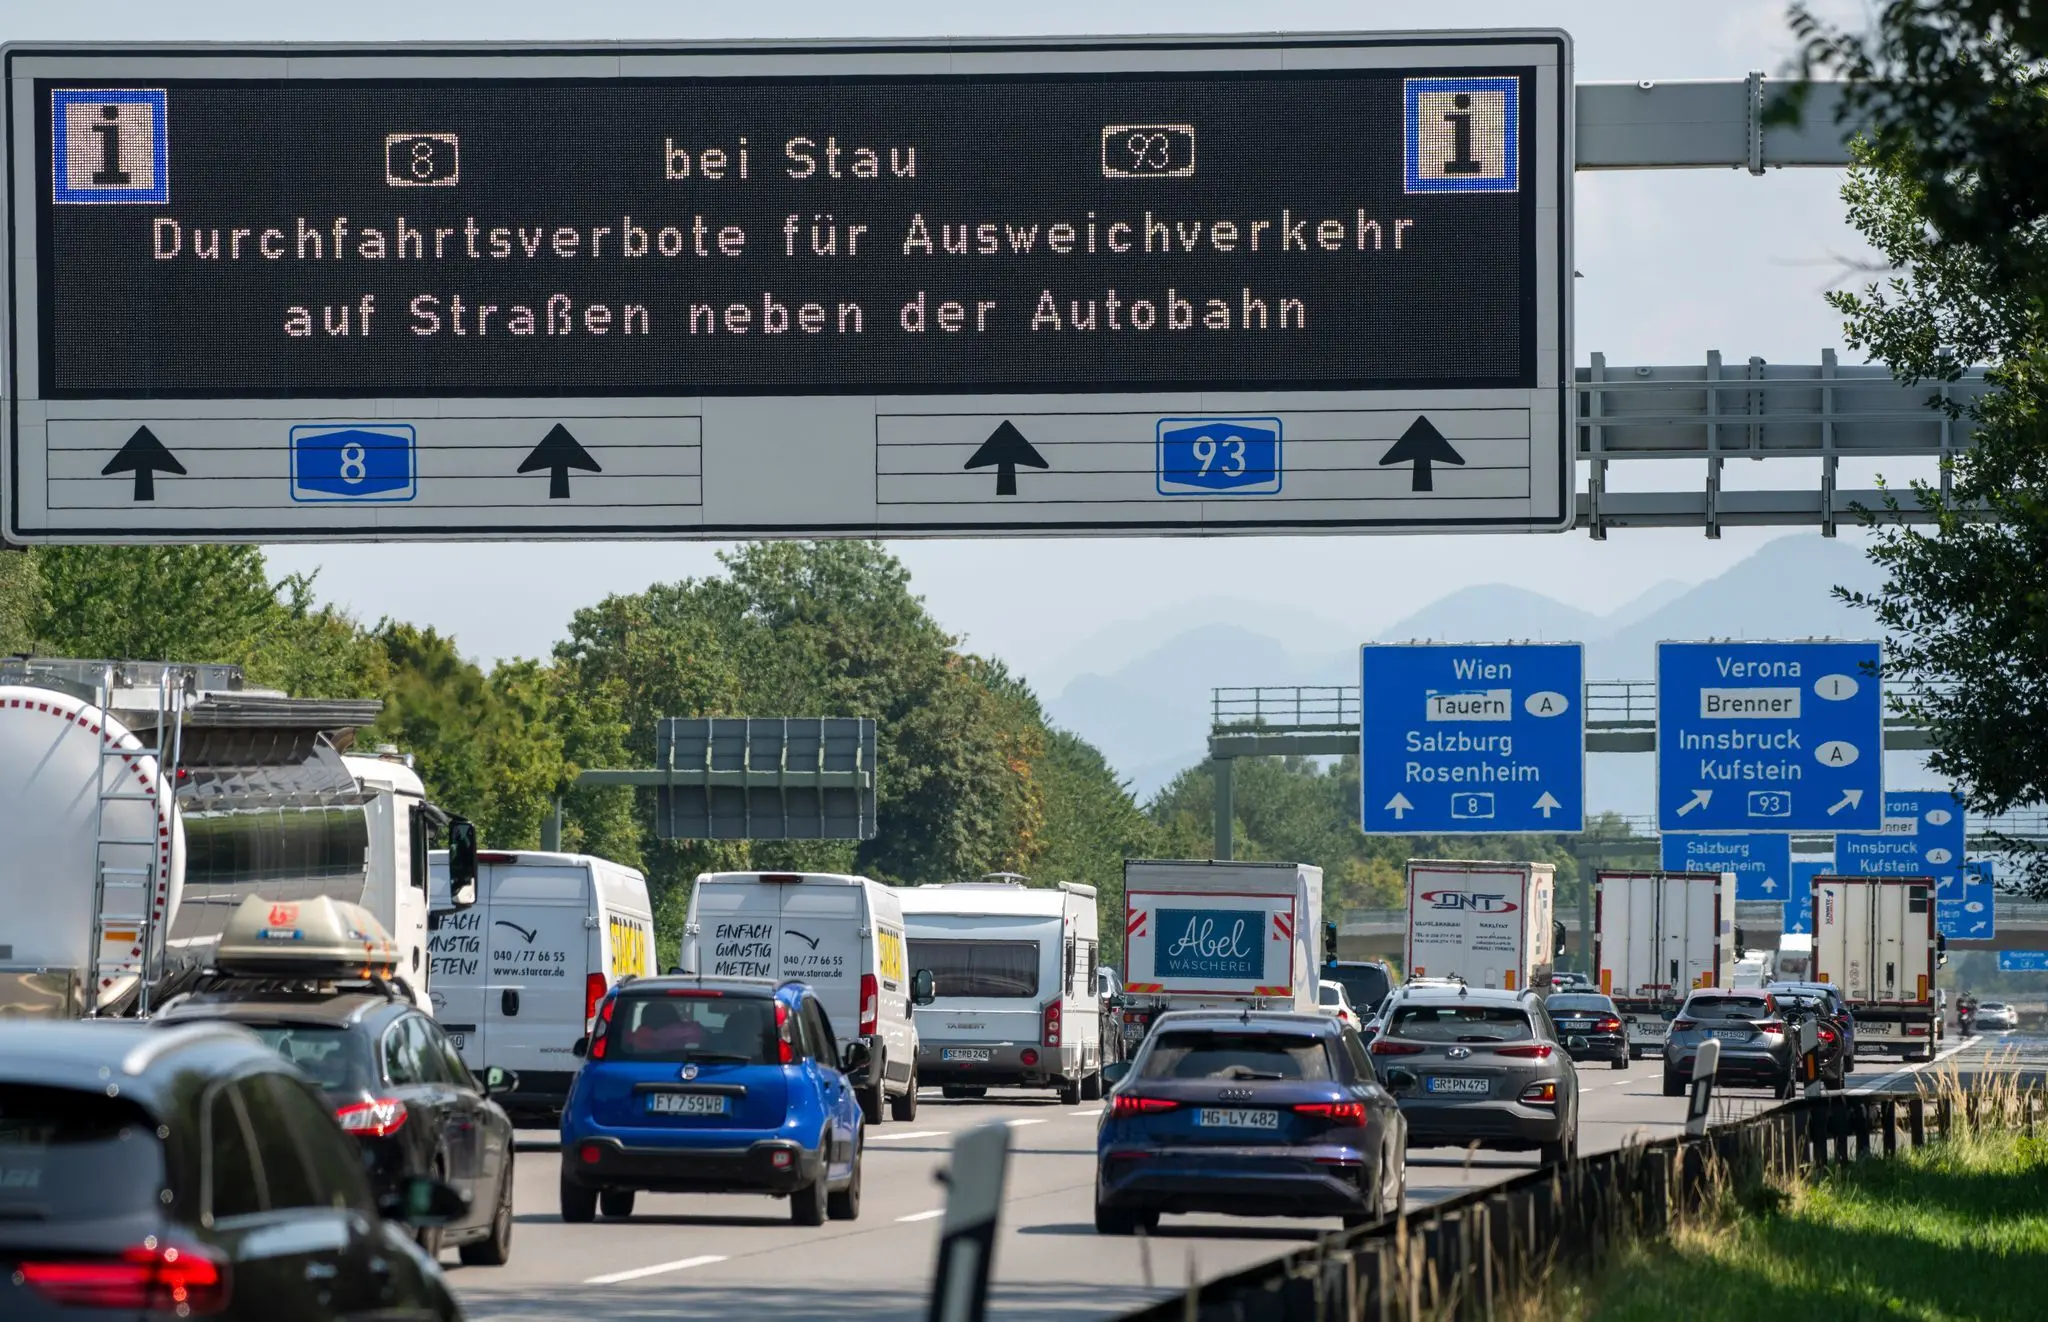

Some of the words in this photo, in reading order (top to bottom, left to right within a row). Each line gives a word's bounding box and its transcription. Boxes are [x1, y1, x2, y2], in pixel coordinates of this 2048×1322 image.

[411, 142, 433, 178] 8
[665, 137, 748, 180] bei
[785, 136, 915, 179] Stau
[1127, 133, 1170, 170] 93
[154, 216, 745, 260] Durchfahrtsverbote
[783, 213, 867, 256] für
[902, 208, 1414, 255] Ausweichverkehr
[284, 294, 375, 337] auf
[410, 293, 649, 336] Straßen
[690, 291, 862, 335] neben
[900, 290, 996, 333] der
[1032, 287, 1305, 331] Autobahn
[340, 442, 366, 485] 8
[1192, 435, 1247, 478] 93
[1453, 657, 1512, 680] Wien
[1716, 656, 1801, 678] Verona
[1433, 696, 1505, 714] Tauern
[1540, 697, 1553, 713] A
[1707, 694, 1793, 713] Brenner
[1406, 730, 1513, 757] Salzburg
[1679, 728, 1801, 750] Innsbruck
[1830, 746, 1843, 762] A
[1406, 760, 1540, 783] Rosenheim
[1701, 759, 1802, 780] Kufstein
[1468, 798, 1478, 814] 8
[1759, 796, 1780, 812] 93
[1886, 802, 1919, 812] rona
[1885, 823, 1913, 832] nner
[1687, 841, 1750, 857] Salzburg
[1847, 841, 1919, 855] Innsbruck
[1685, 859, 1767, 872] Rosenheim
[1860, 858, 1920, 873] Kufstein
[1431, 893, 1506, 911] DNT
[1167, 915, 1251, 959] Abel
[493, 950, 512, 961] 040
[523, 951, 536, 962] 77
[538, 951, 550, 962] 66
[553, 951, 565, 962] 55
[783, 955, 799, 965] 040
[807, 956, 819, 965] 77
[820, 956, 831, 965] 66
[833, 956, 843, 966] 55
[493, 966, 565, 977] www.starcar.de
[783, 968, 843, 978] www.starcar.de
[1168, 958, 1251, 972] WÄSCHEREI
[1468, 1080, 1487, 1091] 475
[1201, 1110, 1220, 1125] HG
[1228, 1111, 1248, 1125] LY
[1250, 1111, 1277, 1127] 482
